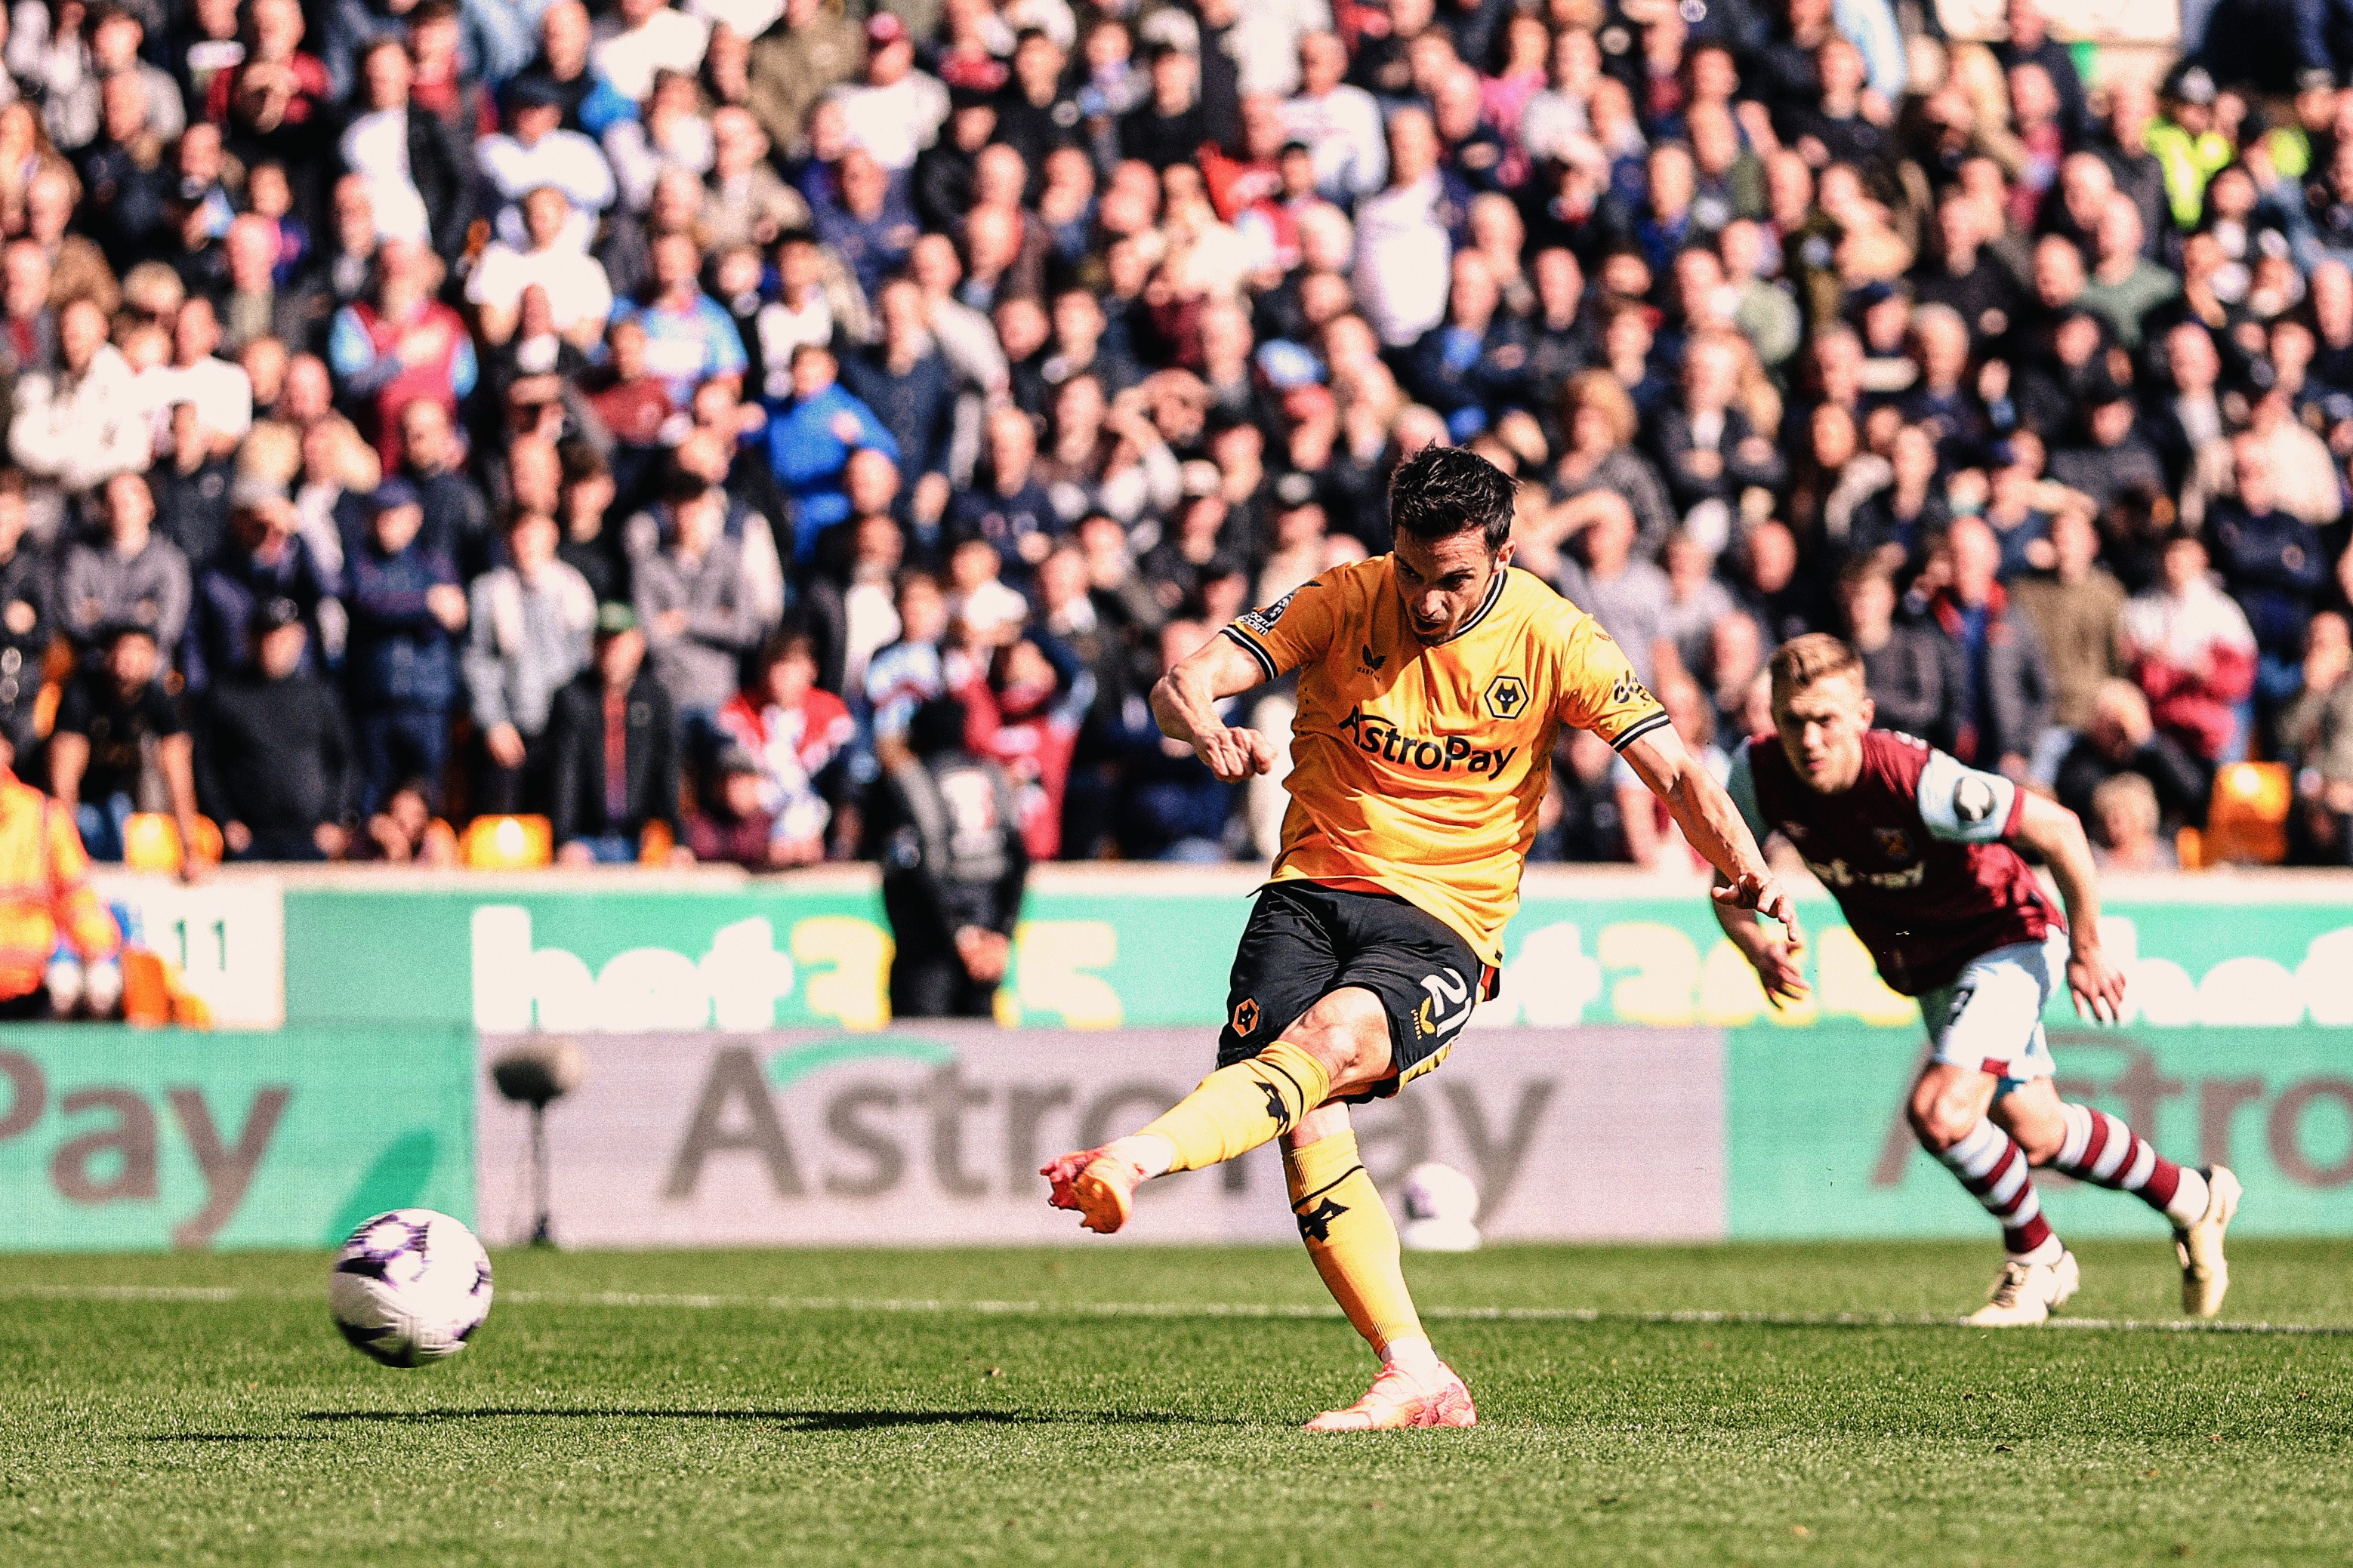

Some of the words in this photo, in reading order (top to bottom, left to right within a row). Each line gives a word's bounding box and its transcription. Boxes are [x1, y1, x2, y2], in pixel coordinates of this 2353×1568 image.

[1338, 705, 1518, 781] AstroPay
[471, 905, 1122, 1031] bet35
[1420, 967, 1472, 1038] 21
[660, 1044, 1559, 1229] Astroay
